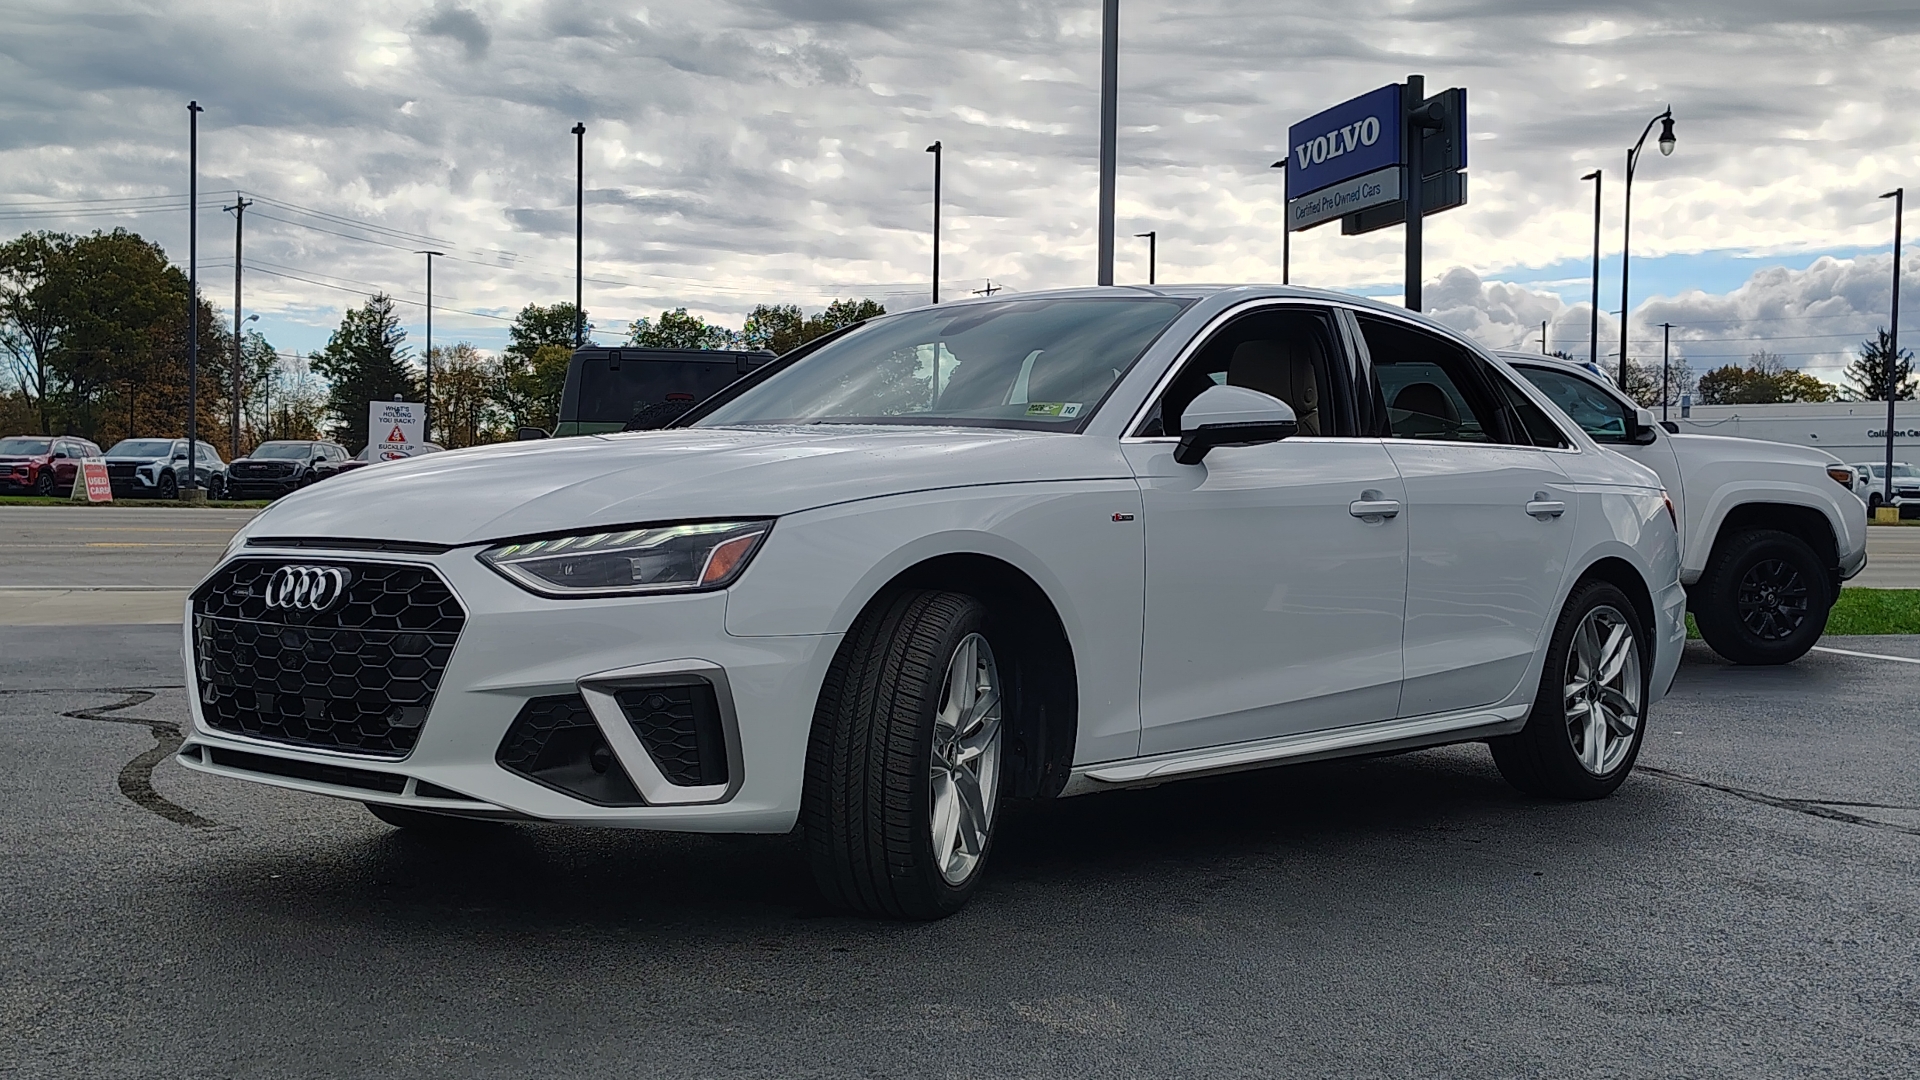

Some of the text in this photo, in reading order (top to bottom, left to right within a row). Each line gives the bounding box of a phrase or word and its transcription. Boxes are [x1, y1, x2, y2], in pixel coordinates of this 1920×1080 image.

[1295, 116, 1380, 170] VOLVO
[1296, 183, 1381, 220] Certified Pre Owned Cars
[1064, 406, 1076, 414] 10
[1867, 429, 1920, 438] Collion Ce
[88, 477, 106, 485] USED
